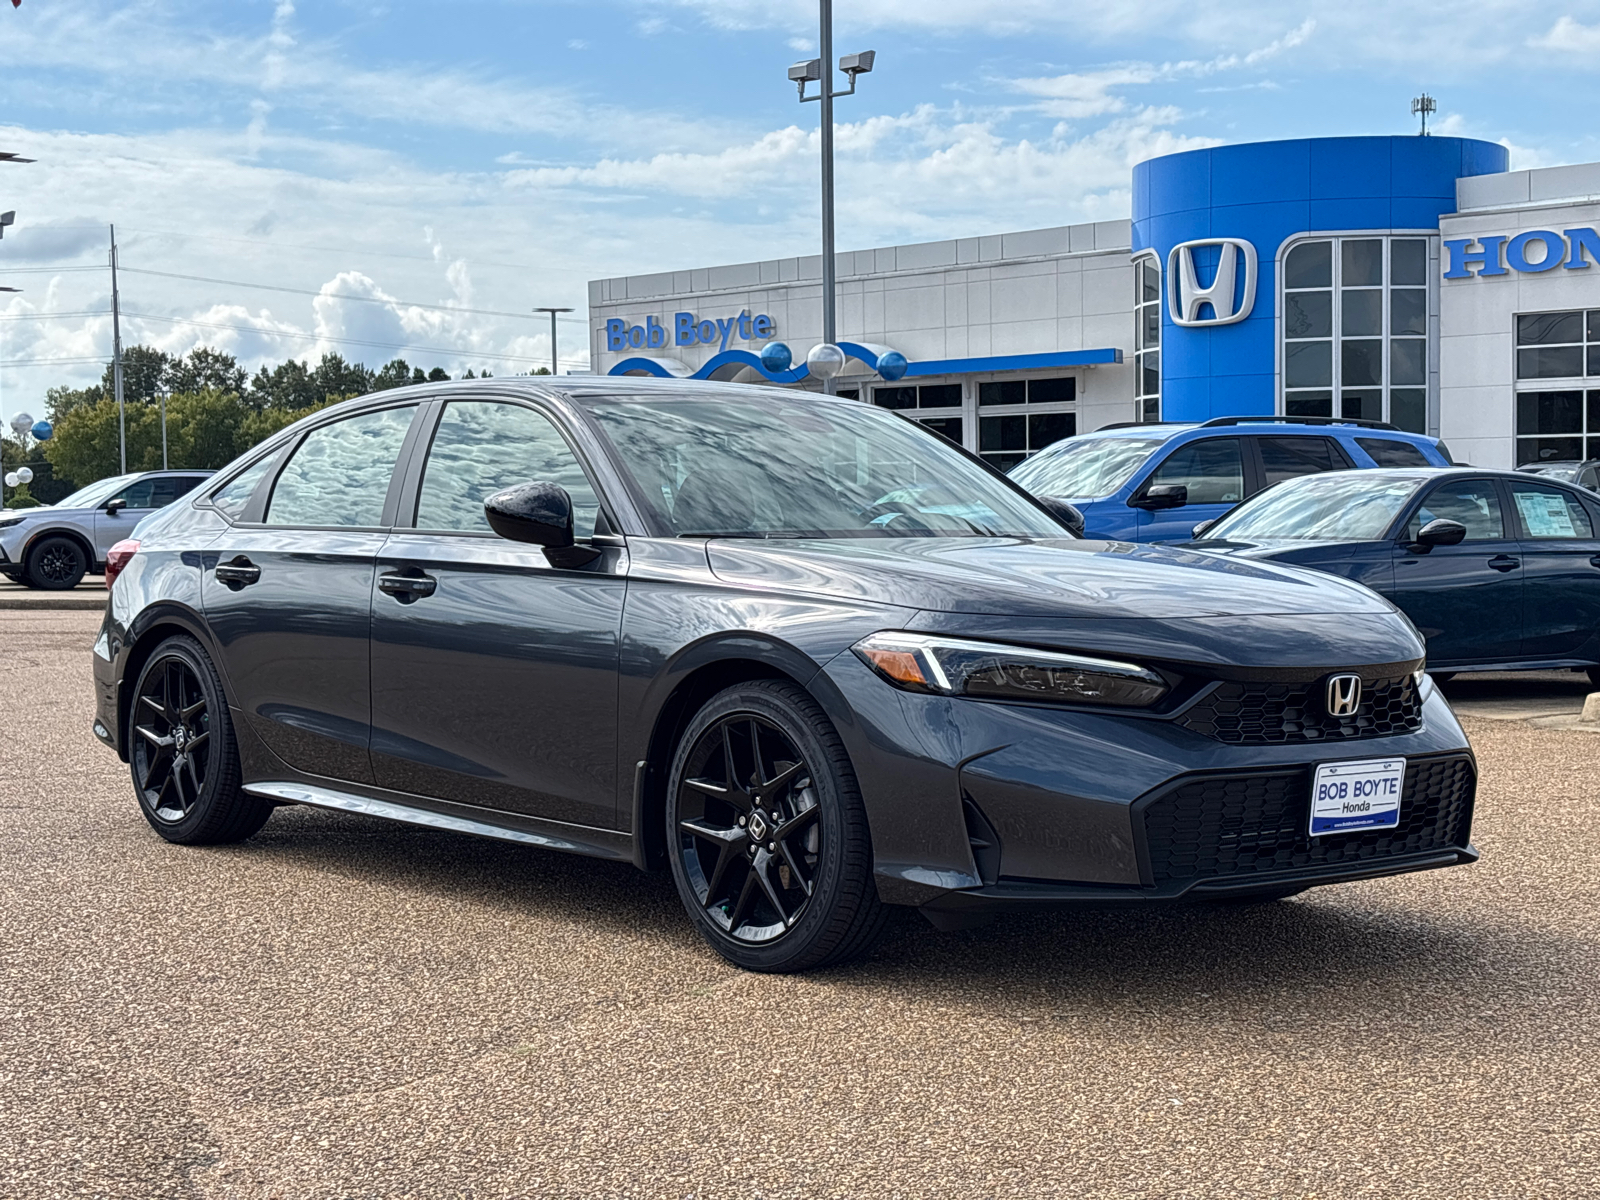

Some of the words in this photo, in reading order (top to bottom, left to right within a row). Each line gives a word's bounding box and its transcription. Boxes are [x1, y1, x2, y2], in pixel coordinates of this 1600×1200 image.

[606, 315, 667, 352] Bob
[675, 309, 774, 353] Boyte
[1318, 782, 1348, 801] BOB
[1353, 777, 1398, 798] BOYTE
[1342, 800, 1371, 814] Honda
